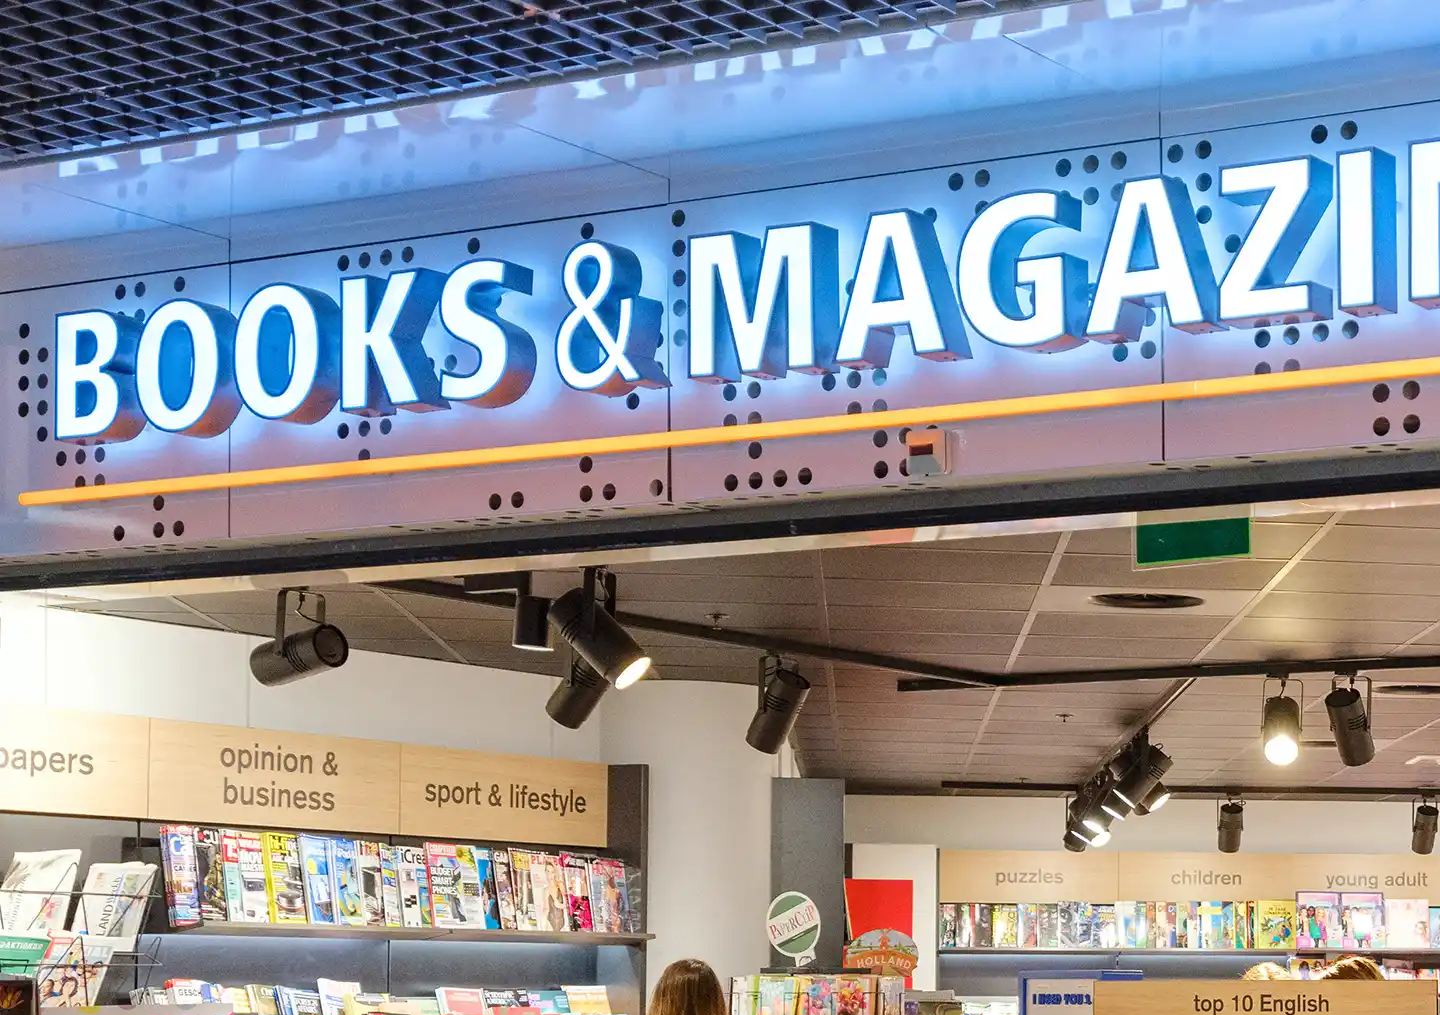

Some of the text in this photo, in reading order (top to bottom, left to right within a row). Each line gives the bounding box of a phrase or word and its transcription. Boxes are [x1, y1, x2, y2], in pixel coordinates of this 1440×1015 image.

[55, 258, 535, 443] BOOKS
[555, 239, 662, 396] &
[220, 743, 339, 776] opinion &
[223, 777, 335, 812] business
[425, 782, 586, 816] sport & lifestyle
[401, 848, 425, 864] iCrea
[431, 866, 454, 875] BUDGET
[995, 869, 1064, 886] puzzles
[1171, 869, 1242, 886] children
[1326, 872, 1428, 889] young adult
[432, 886, 457, 895] PHONES
[857, 956, 912, 970] HOLLAND
[1194, 993, 1330, 1015] top 10 English
